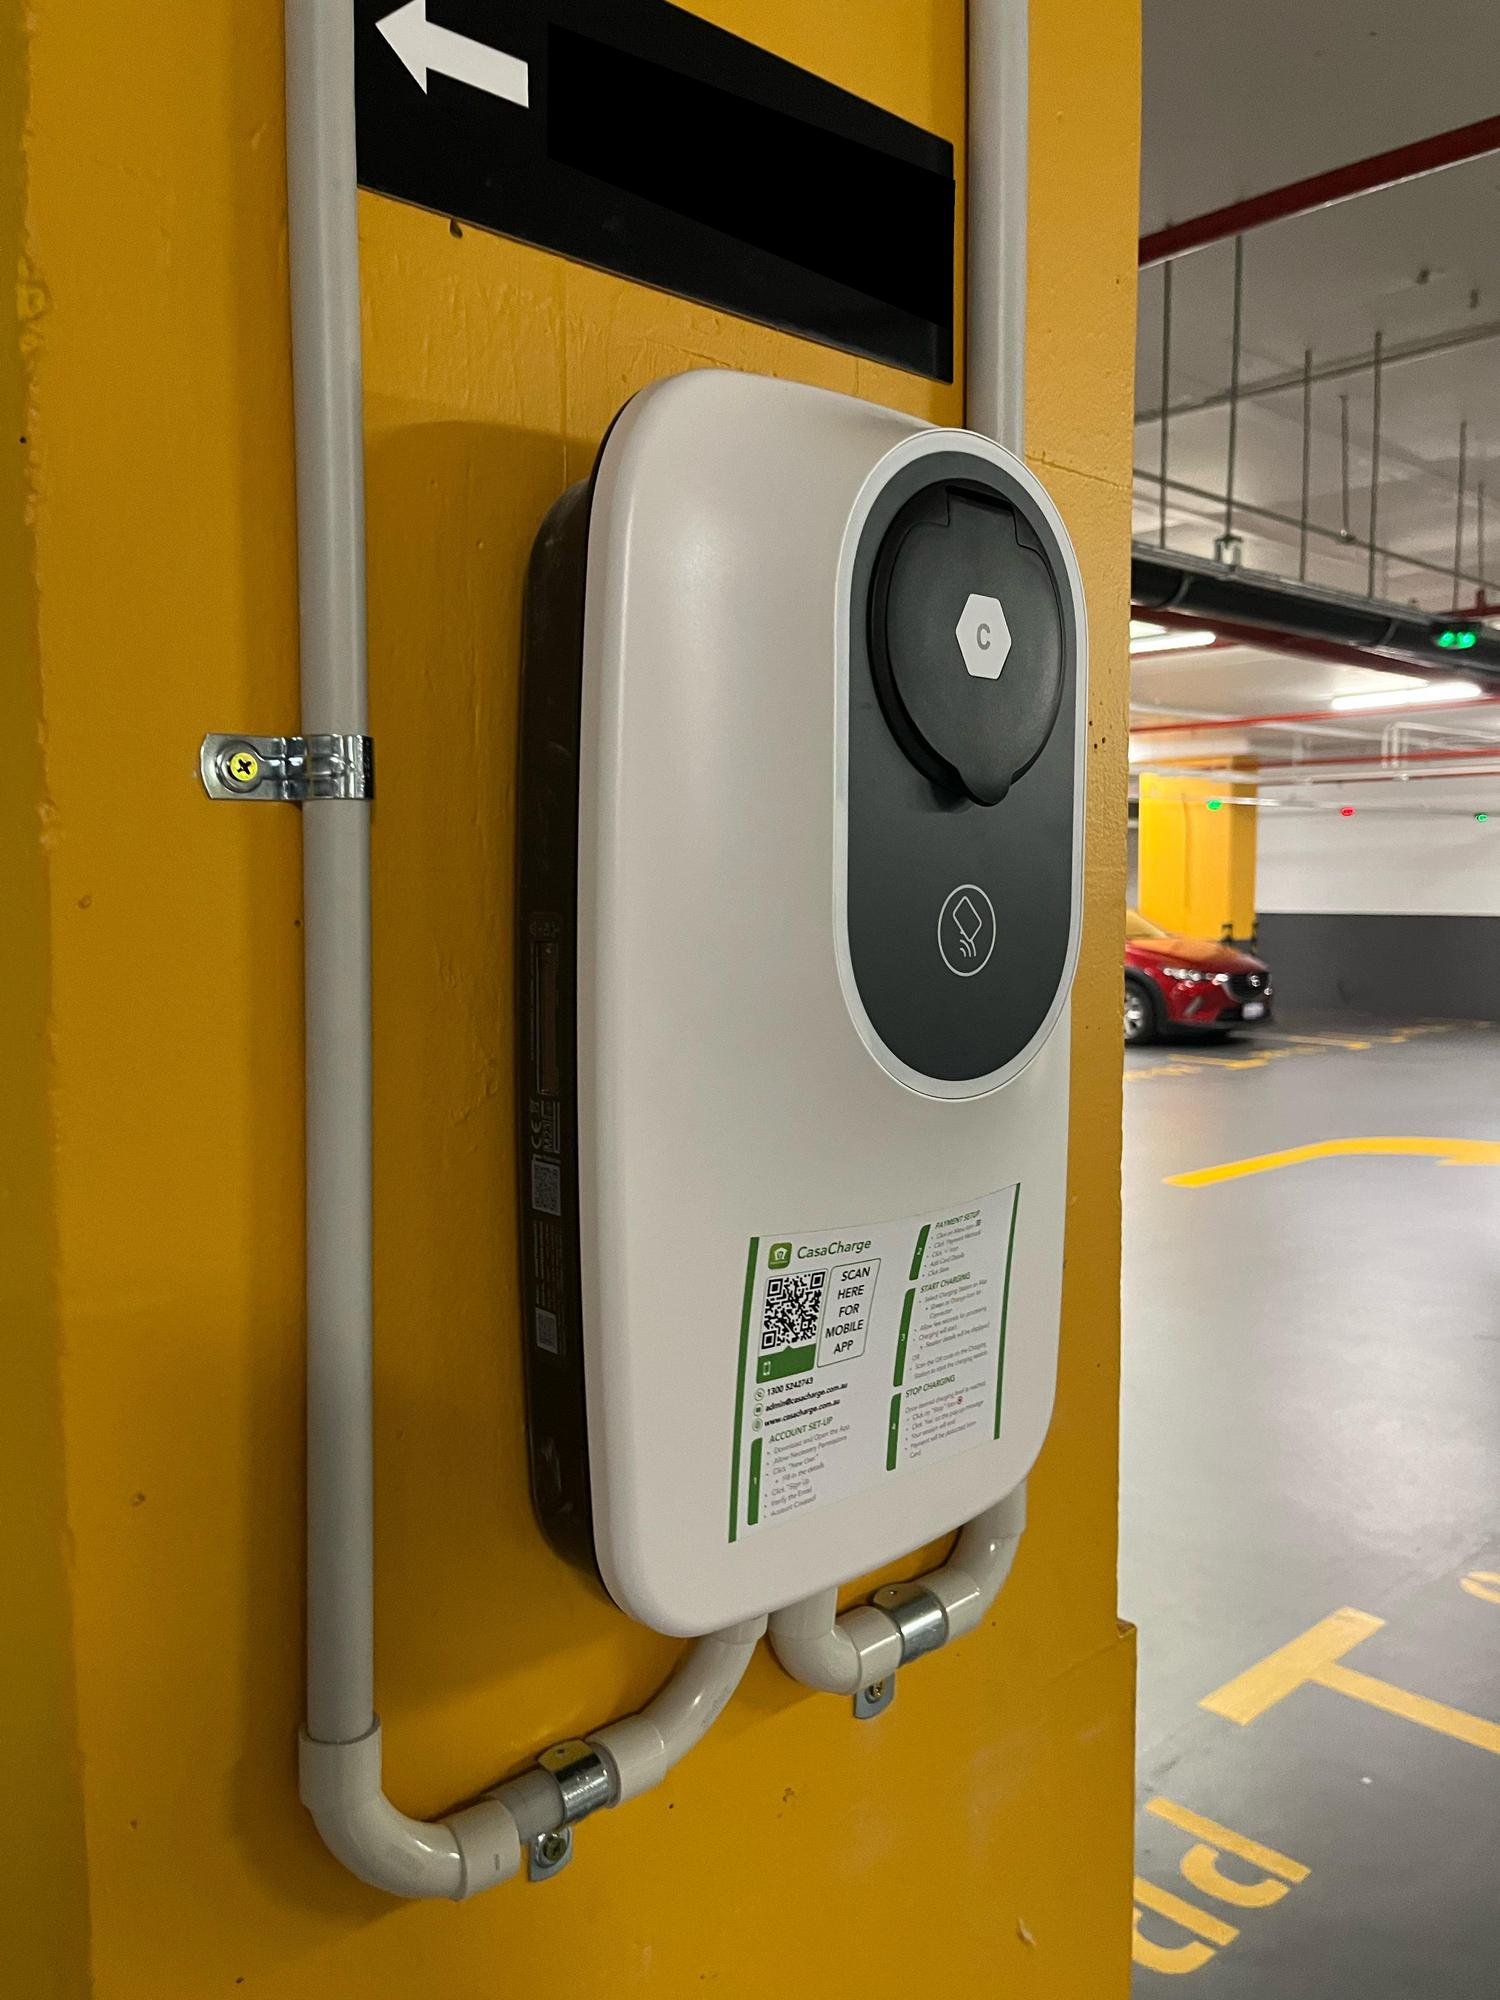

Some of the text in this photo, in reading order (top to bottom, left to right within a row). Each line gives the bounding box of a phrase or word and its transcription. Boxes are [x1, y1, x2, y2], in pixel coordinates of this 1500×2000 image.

[976, 623, 990, 650] C
[934, 1215, 963, 1229] PAYMENT
[796, 1240, 871, 1259] CasaCharge
[841, 1266, 871, 1282] SCAN
[920, 1271, 971, 1293] START CHARGING
[837, 1284, 865, 1300] HERE
[838, 1303, 860, 1318] FOR
[825, 1319, 864, 1338] MOBILE
[833, 1339, 854, 1354] APP
[767, 1384, 784, 1396] 1300
[905, 1374, 956, 1398] STOP CHARGING
[765, 1383, 848, 1412] admin@casacharge.com.au
[764, 1399, 840, 1427] www.casacharge.com.au
[769, 1416, 833, 1444] ACCOUNT SET-UP
